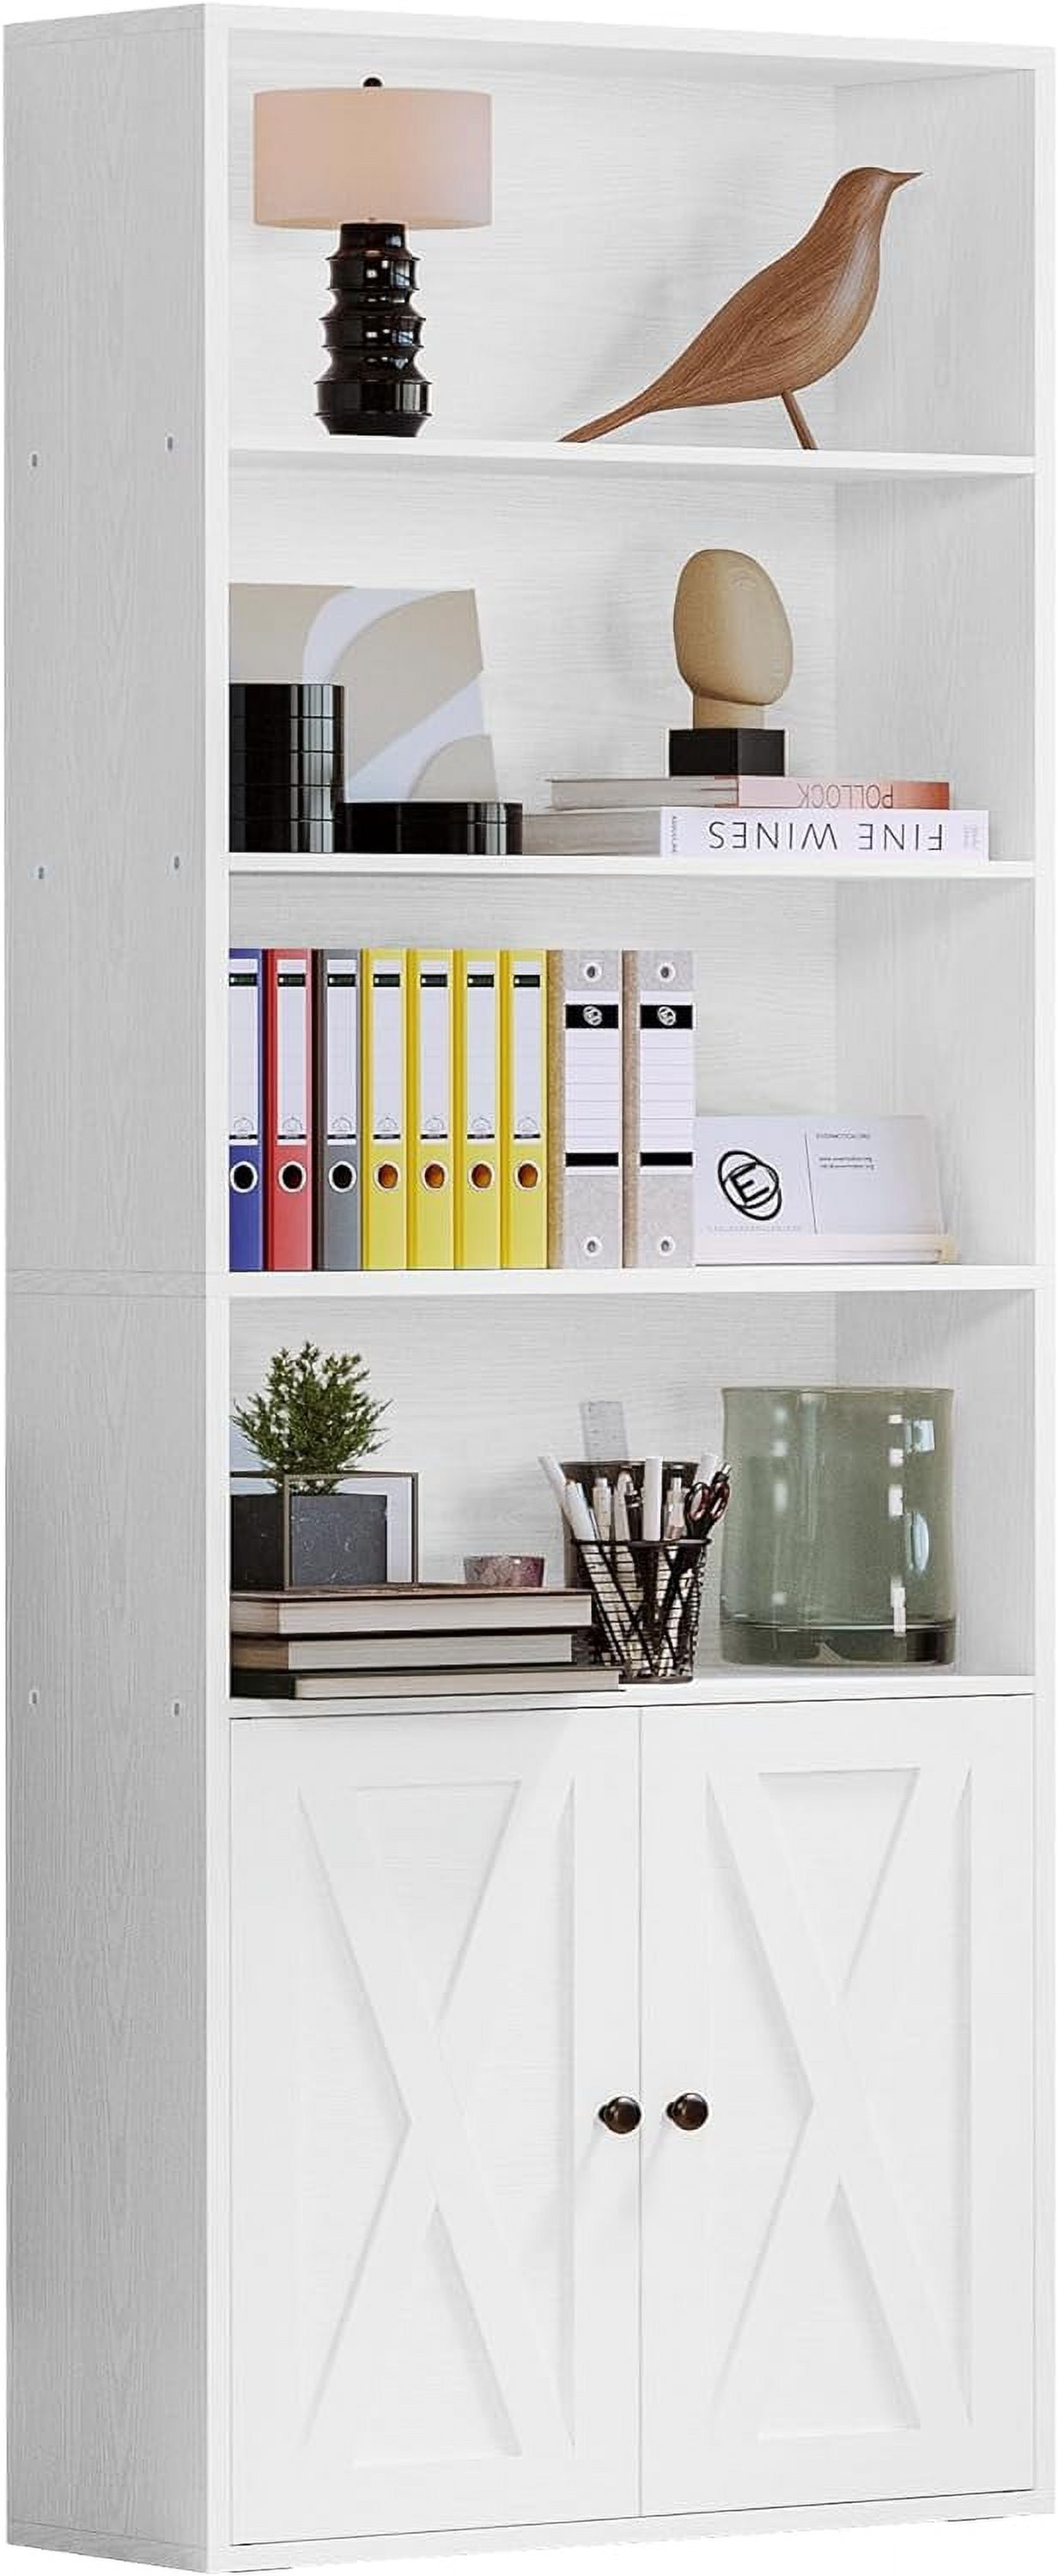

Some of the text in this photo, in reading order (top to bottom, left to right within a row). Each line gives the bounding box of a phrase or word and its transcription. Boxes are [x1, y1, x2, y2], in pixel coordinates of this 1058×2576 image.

[797, 782, 893, 810] POLLOCK
[709, 821, 838, 850] WINES
[860, 823, 944, 851] FINE
